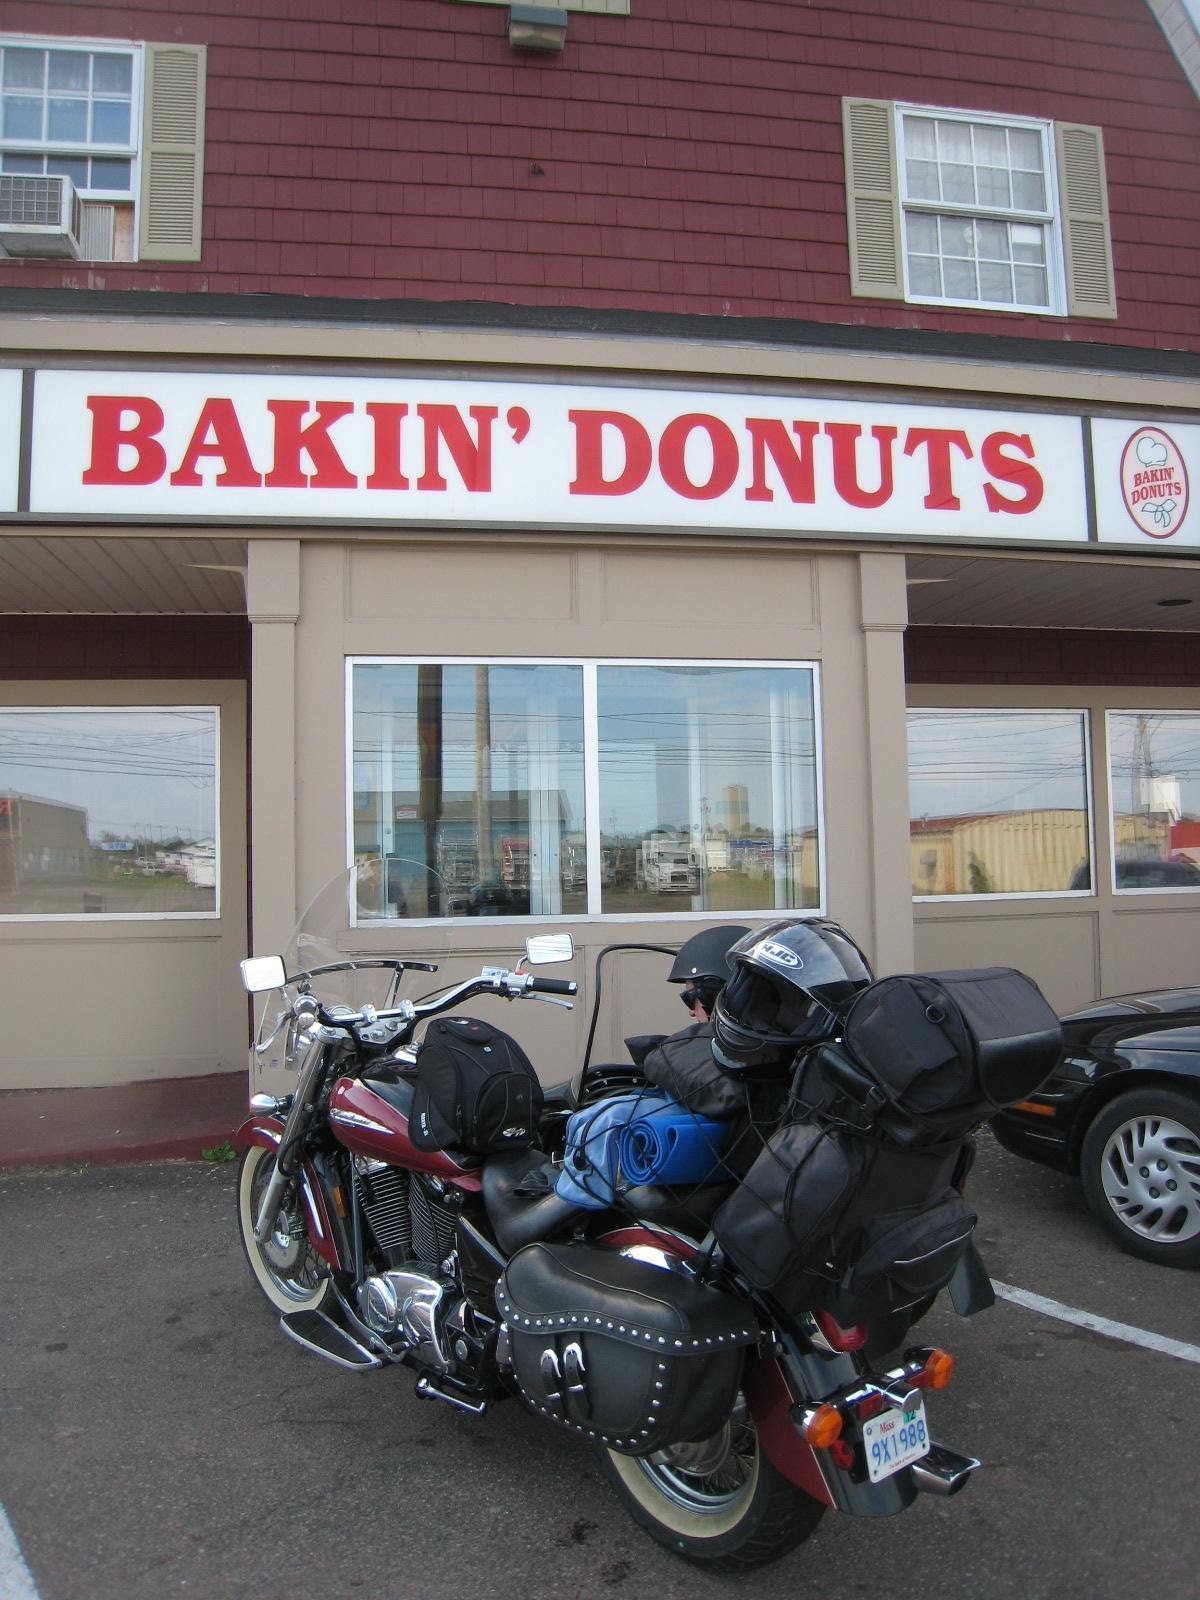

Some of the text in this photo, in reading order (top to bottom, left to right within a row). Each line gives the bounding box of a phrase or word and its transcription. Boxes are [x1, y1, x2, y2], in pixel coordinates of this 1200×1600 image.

[82, 395, 1044, 515] BAKIN' DONUTS
[1133, 467, 1174, 487] BAKIN'
[1131, 482, 1181, 505] DONUTS
[762, 944, 796, 962] HJC
[872, 1420, 925, 1466] 9X1988
